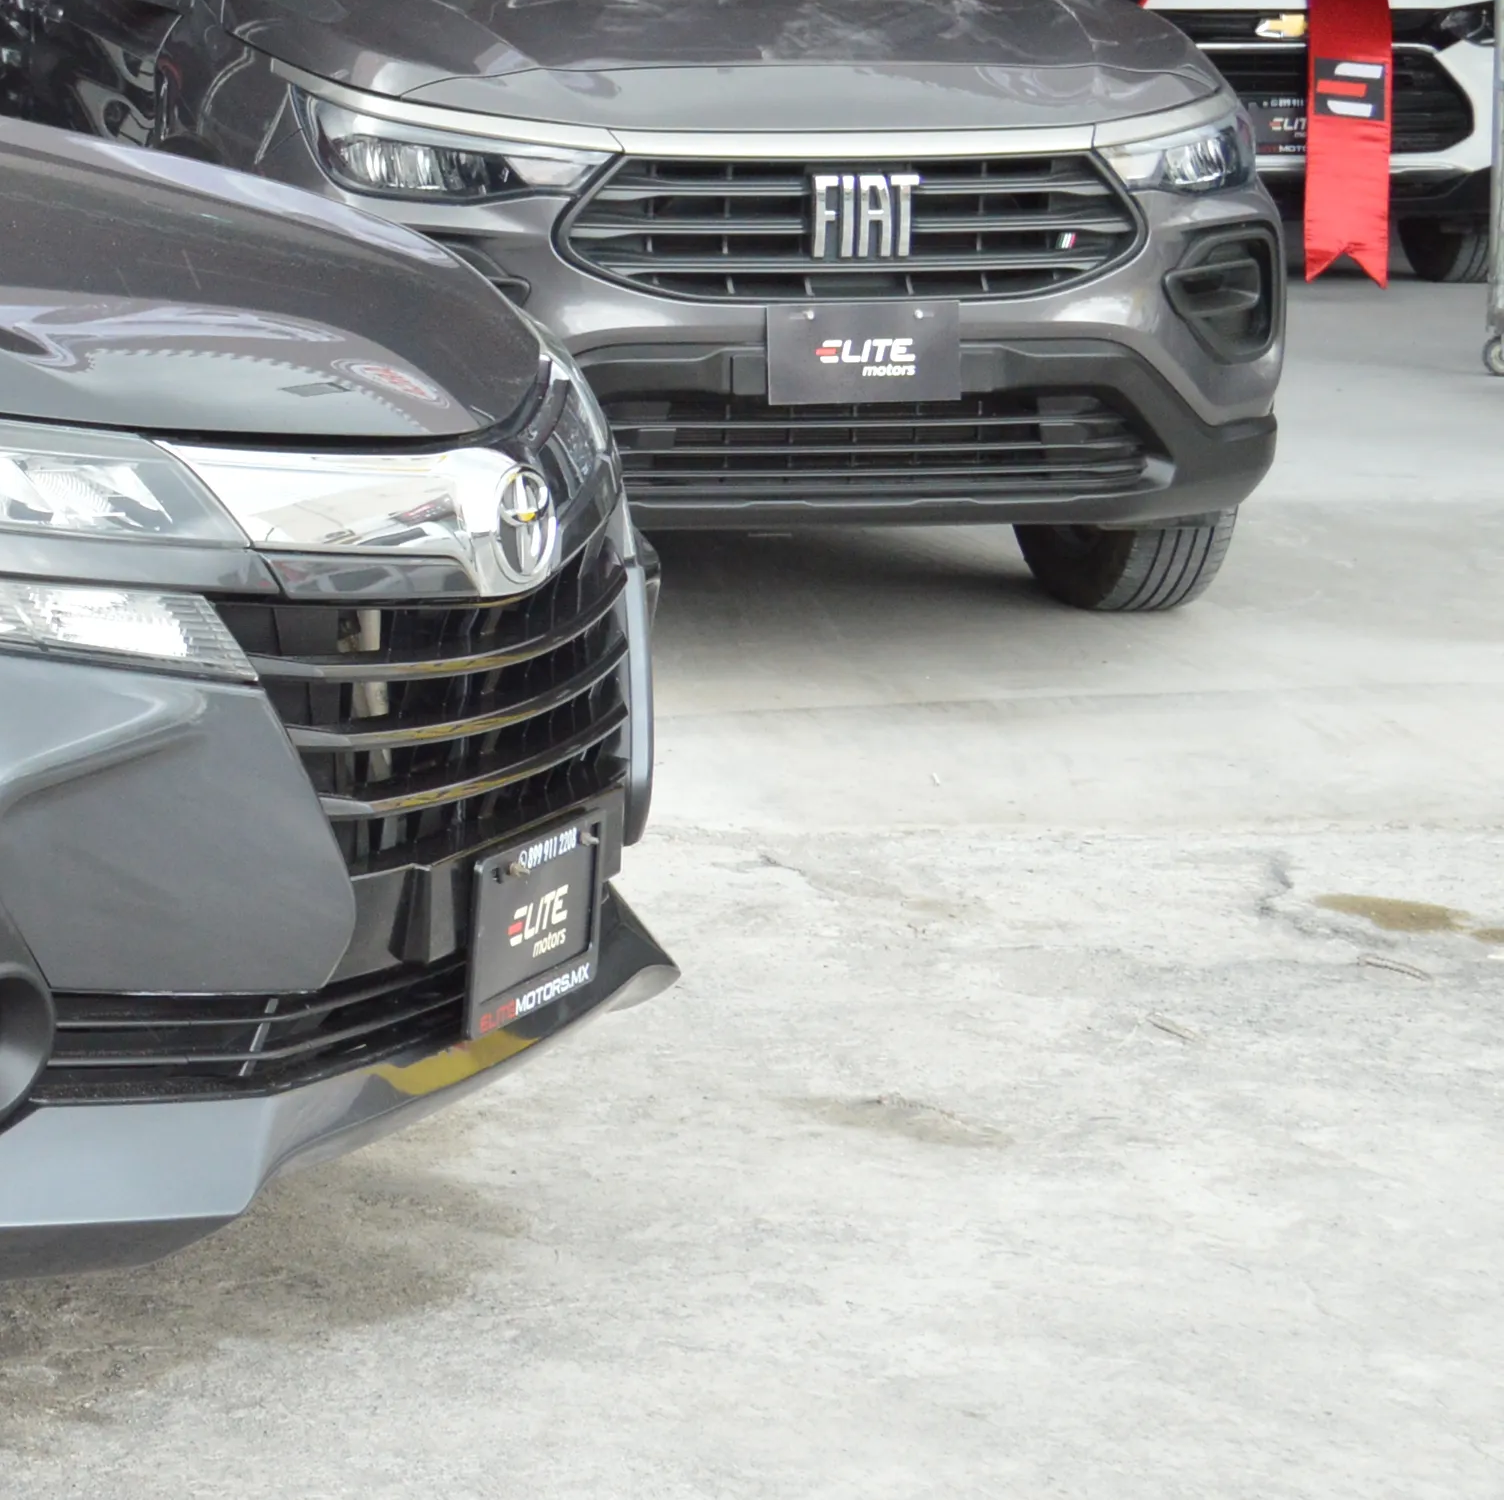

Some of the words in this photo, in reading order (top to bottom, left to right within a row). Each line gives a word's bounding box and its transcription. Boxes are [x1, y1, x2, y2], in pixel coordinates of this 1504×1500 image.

[812, 174, 920, 258] FIAT
[815, 338, 916, 364] ELITE
[861, 362, 916, 377] motors
[507, 884, 569, 947] ELITE
[532, 926, 567, 959] motors
